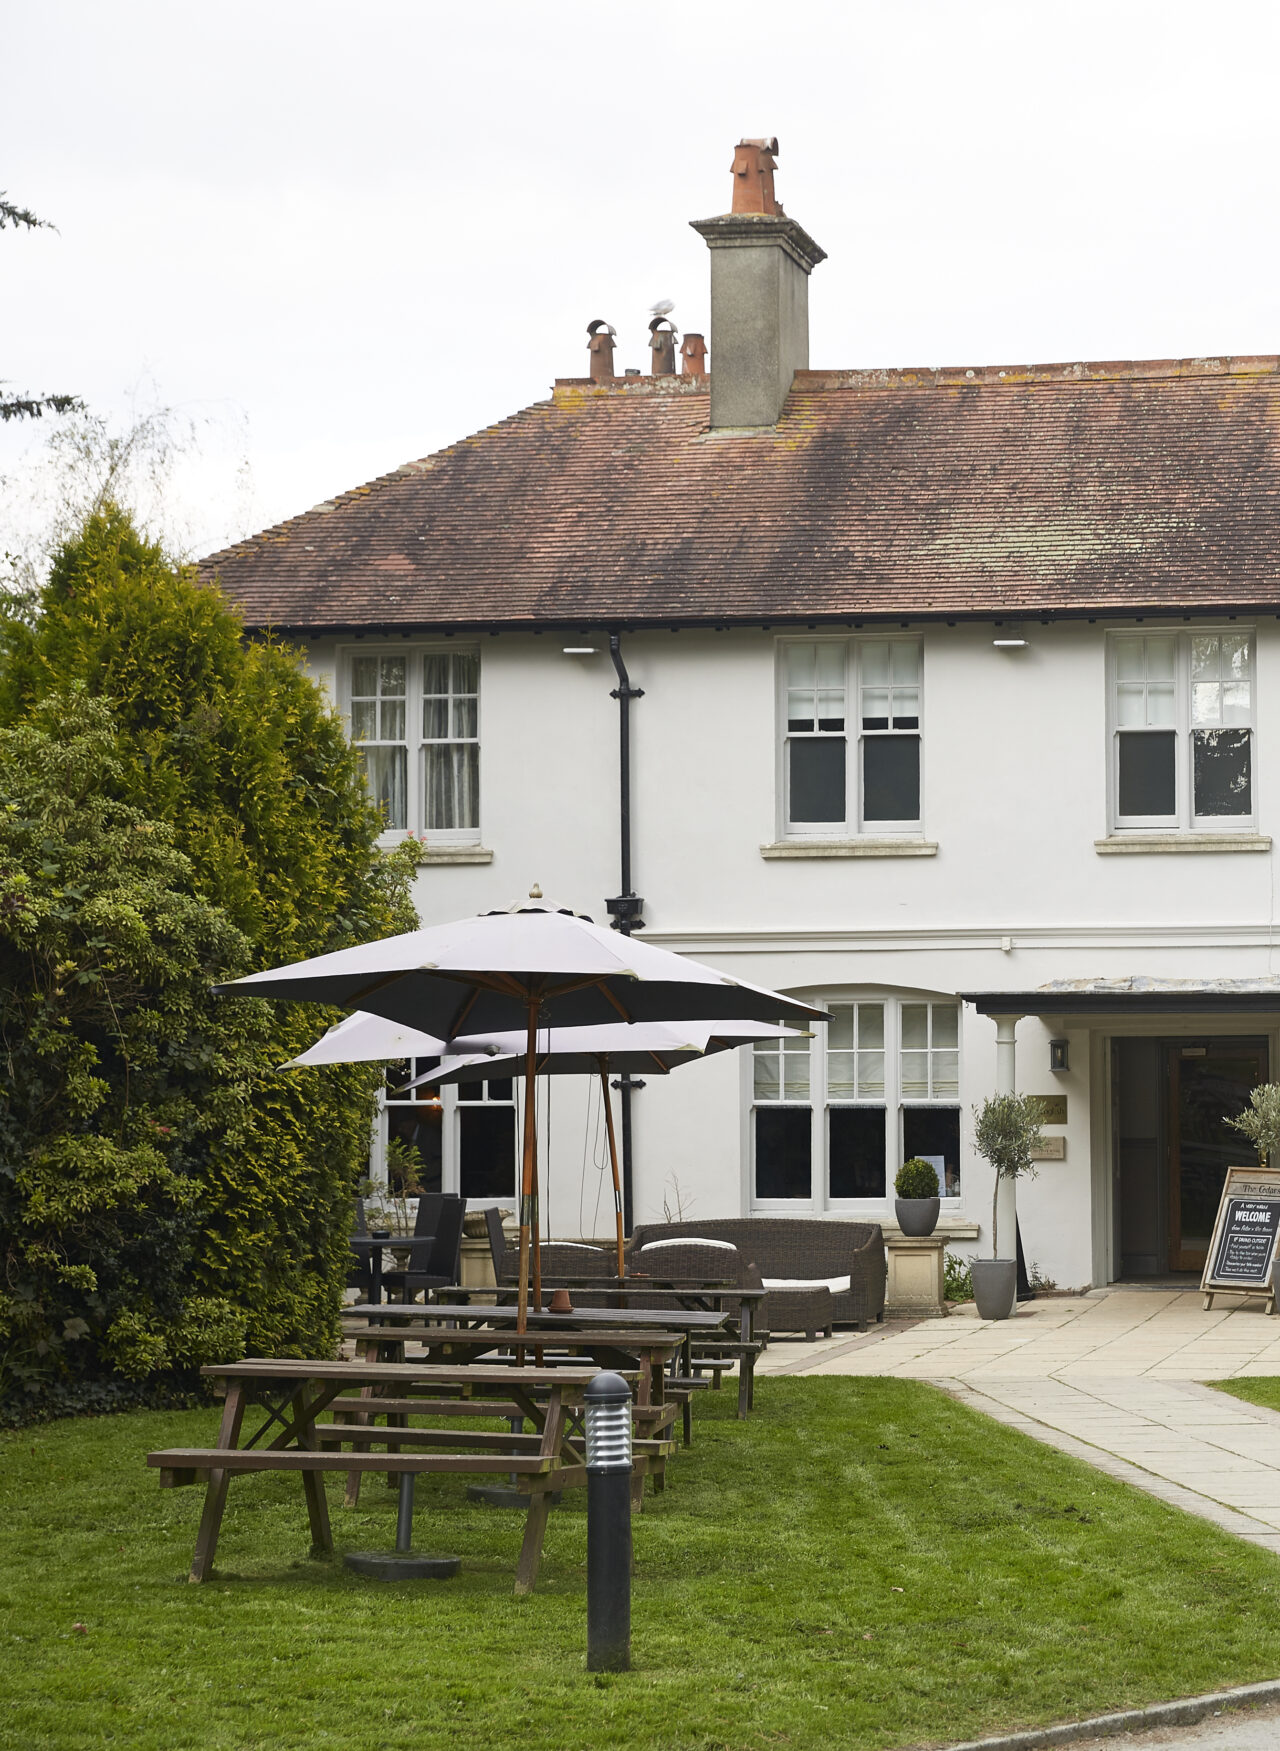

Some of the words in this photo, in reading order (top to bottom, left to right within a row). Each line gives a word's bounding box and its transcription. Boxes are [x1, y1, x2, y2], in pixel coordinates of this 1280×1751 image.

[1243, 1184, 1257, 1193] The
[1259, 1185, 1280, 1194] Cedars
[1235, 1210, 1272, 1223] WELCOME
